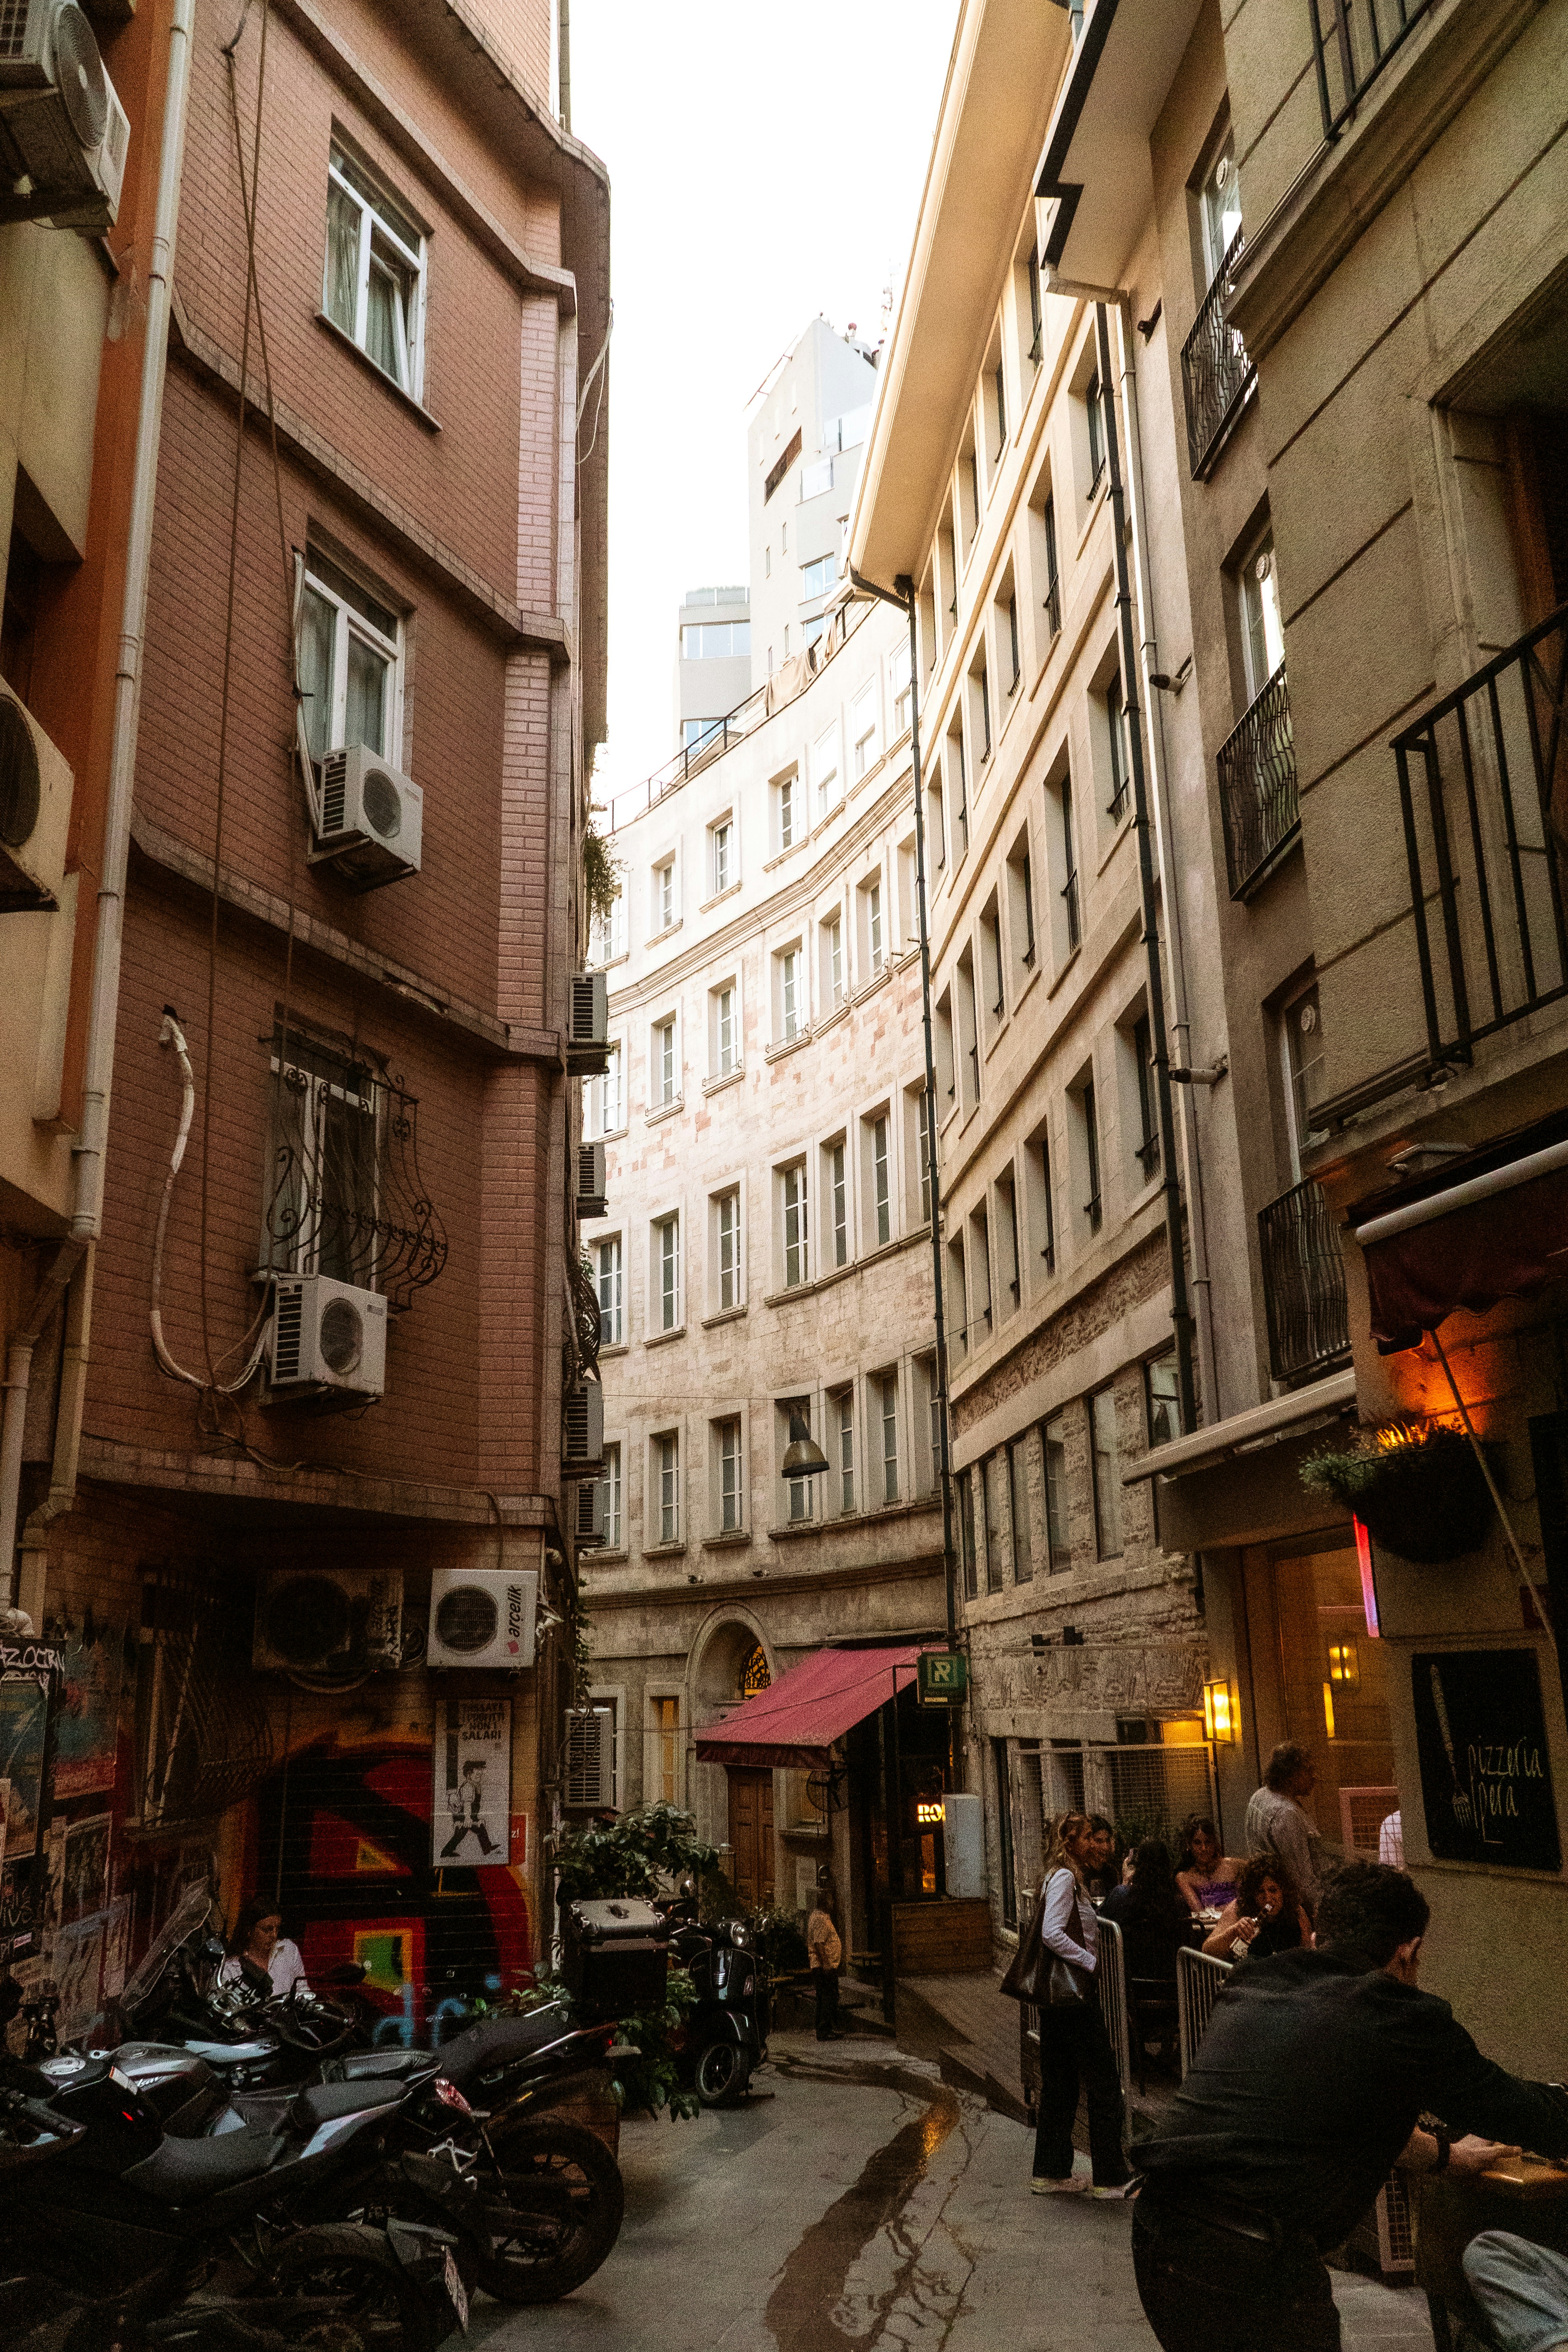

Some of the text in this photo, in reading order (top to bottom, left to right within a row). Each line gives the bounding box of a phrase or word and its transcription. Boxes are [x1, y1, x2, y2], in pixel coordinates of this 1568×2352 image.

[507, 1585, 524, 1637] arçelik
[934, 1661, 951, 1682] R
[467, 1712, 505, 1722] PROFITTI
[469, 1722, 490, 1730] NON
[462, 1730, 502, 1741] SALARI
[917, 1803, 946, 1823] RO
